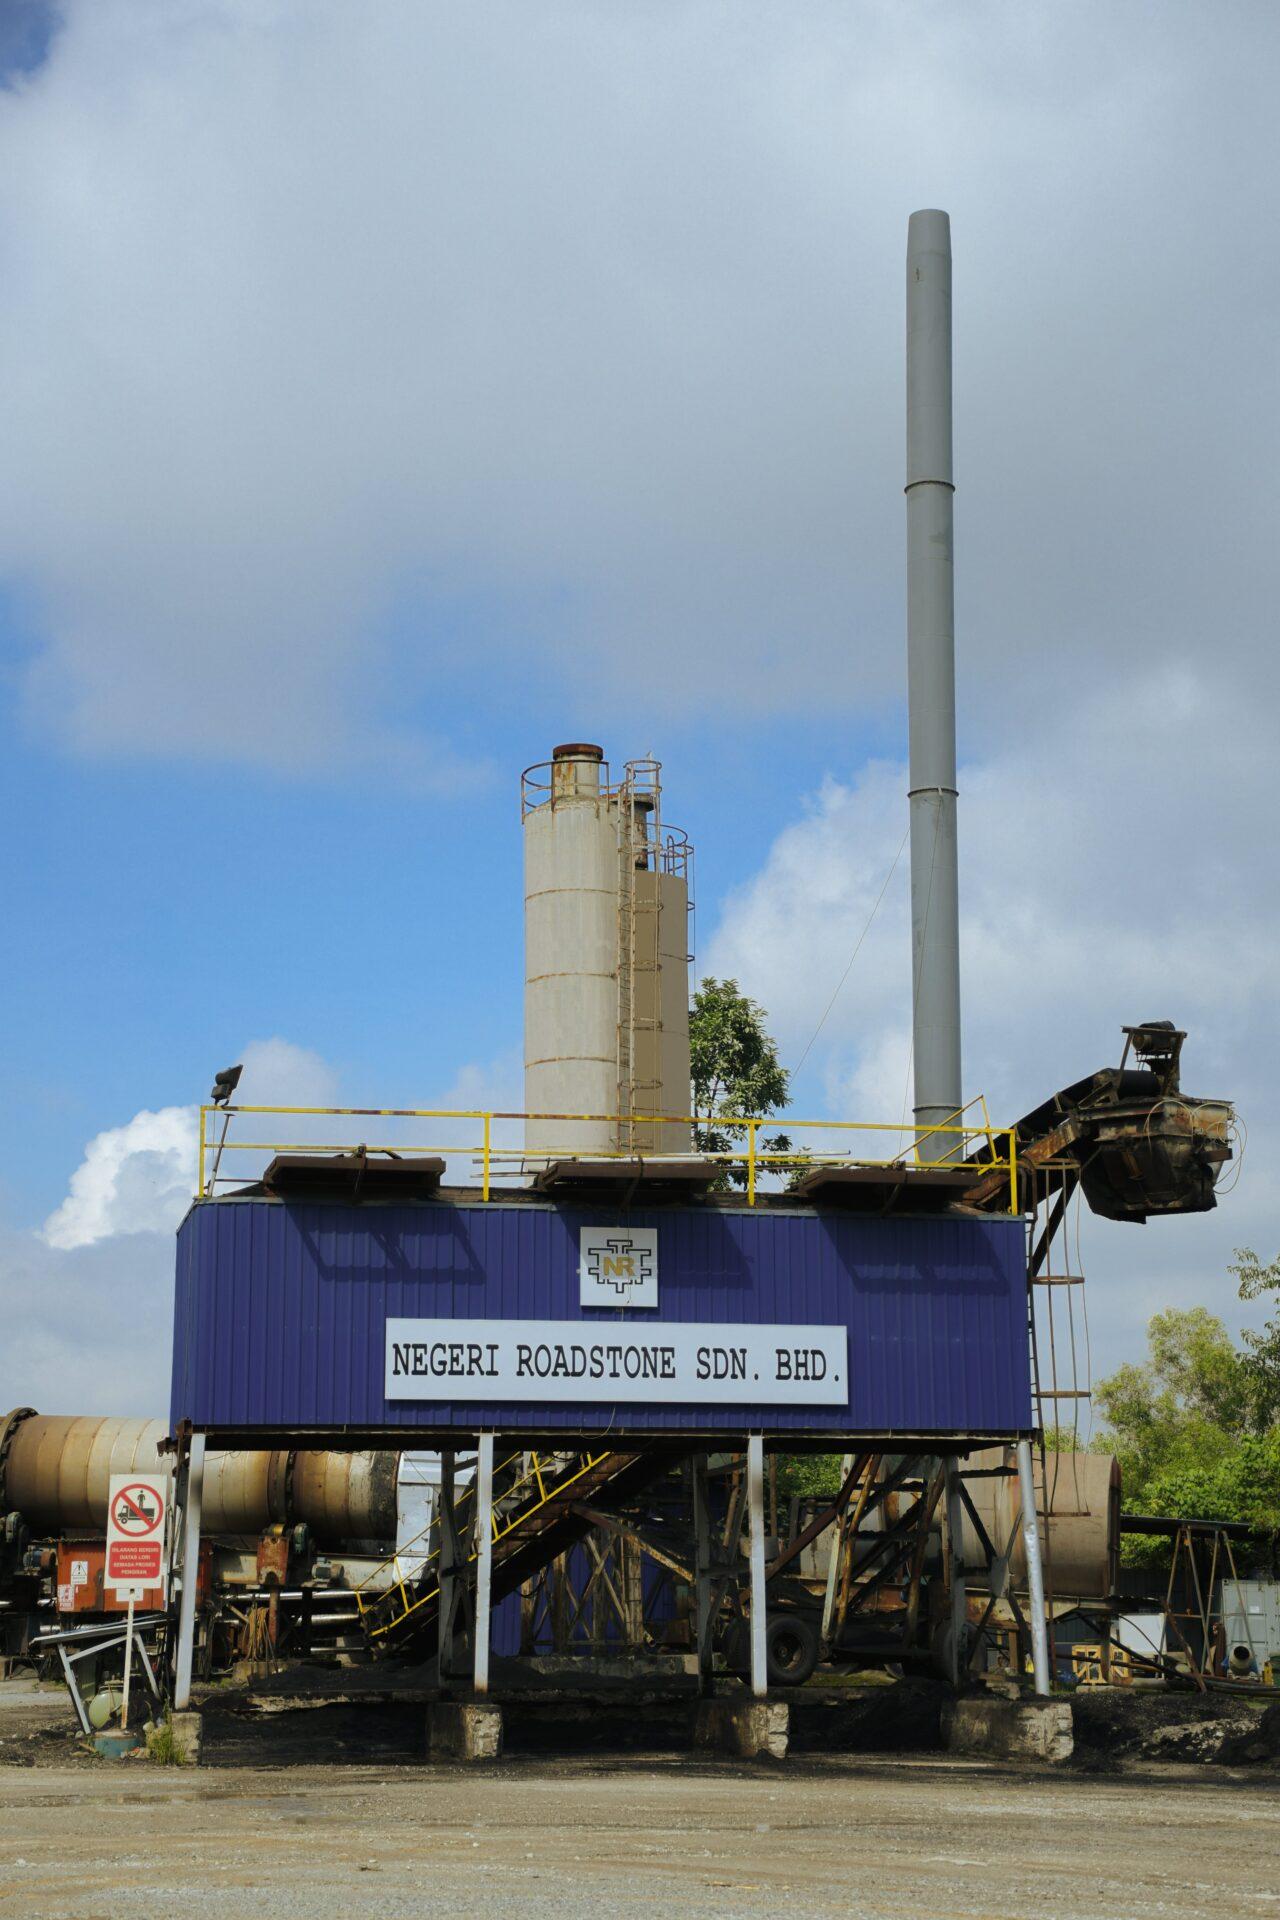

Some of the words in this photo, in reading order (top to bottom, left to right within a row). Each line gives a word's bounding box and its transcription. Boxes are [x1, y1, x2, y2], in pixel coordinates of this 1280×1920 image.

[603, 1256, 635, 1277] NR
[392, 1343, 499, 1376] NEGERI
[516, 1344, 675, 1379] ROADSTONE
[696, 1347, 759, 1380] SDN.
[775, 1349, 840, 1382] BHD.
